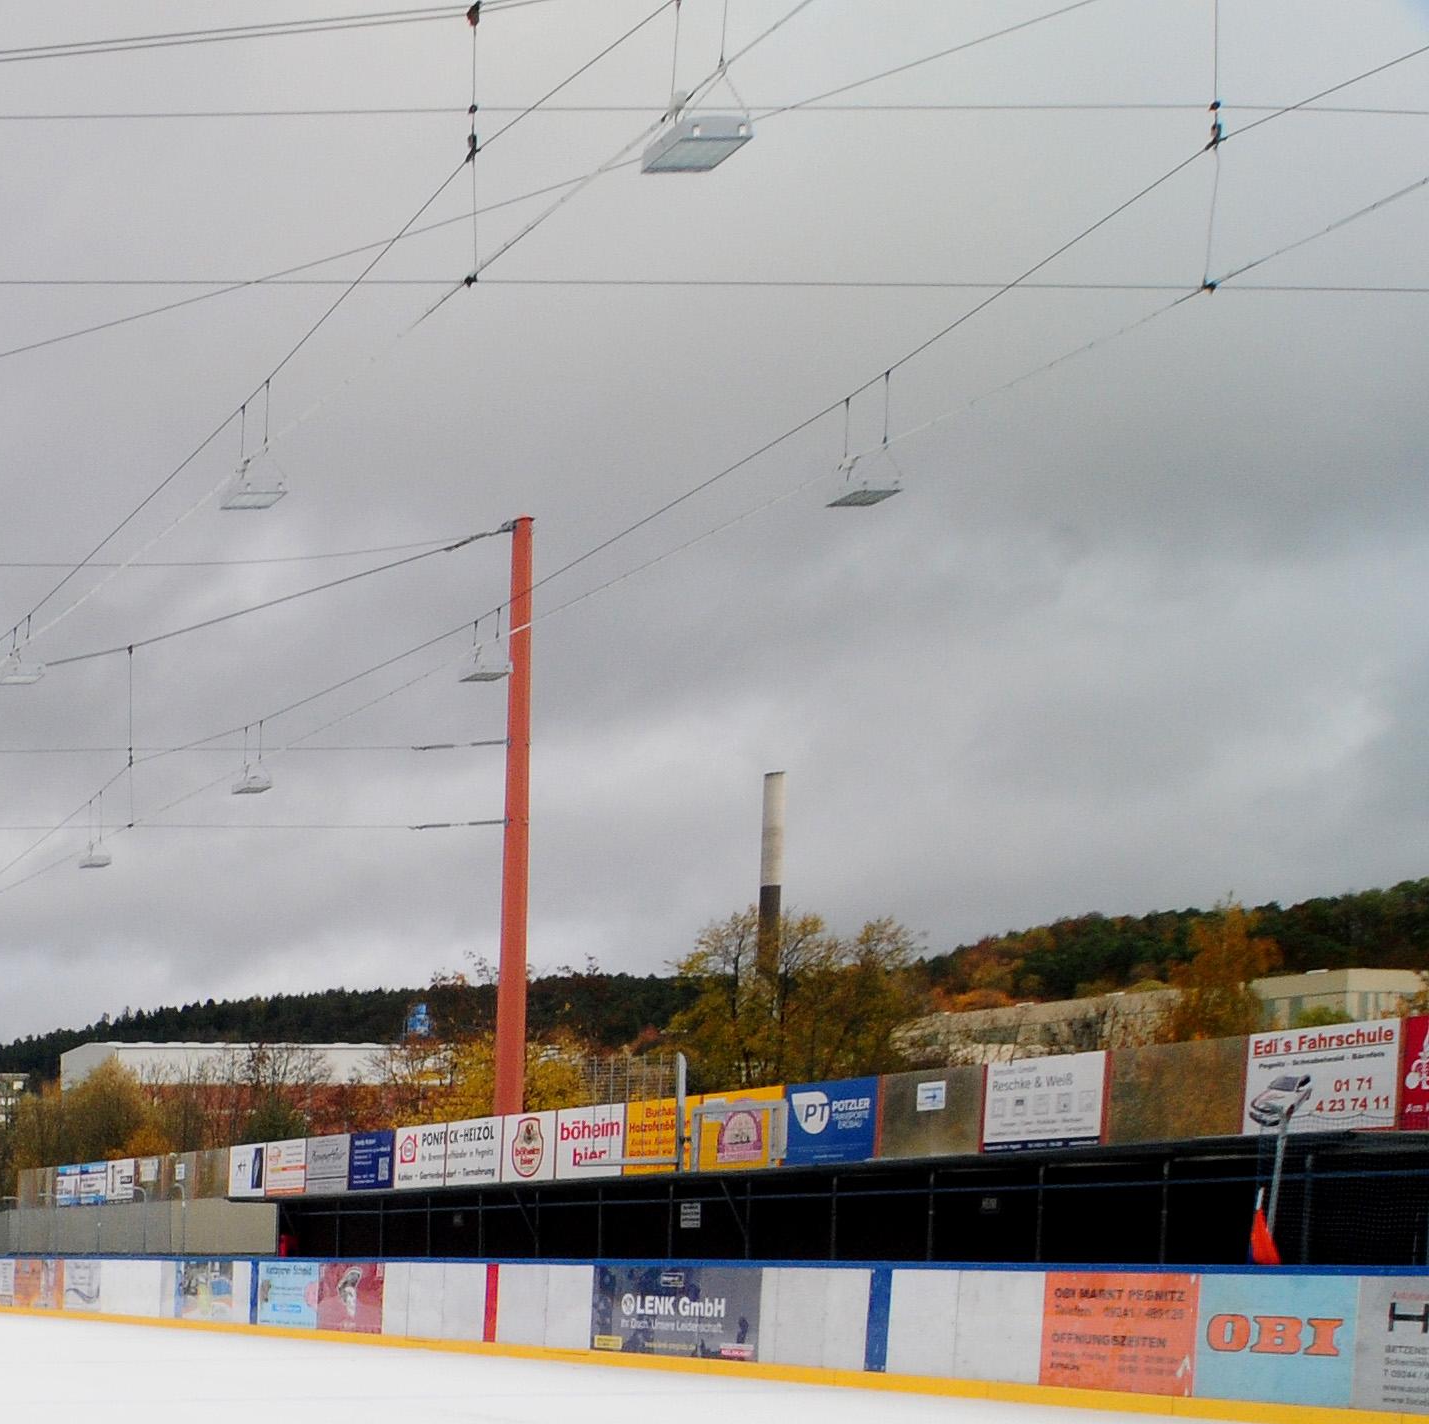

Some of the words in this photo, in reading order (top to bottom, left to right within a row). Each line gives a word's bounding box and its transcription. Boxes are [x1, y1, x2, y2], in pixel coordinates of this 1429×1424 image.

[1298, 1026, 1395, 1051] Fahrschule
[1034, 1076, 1043, 1088] &
[1333, 1079, 1350, 1093] 01
[1356, 1076, 1373, 1091] 71
[804, 1103, 830, 1123] PT
[1316, 1101, 1324, 1113] 4
[1328, 1099, 1346, 1113] 23
[1351, 1098, 1368, 1112] 74
[1373, 1095, 1390, 1110] 11
[560, 1118, 620, 1141] böheim
[1079, 1288, 1124, 1300] MARKT
[1128, 1289, 1187, 1302] PEGNITZ
[636, 1295, 676, 1316] LENK
[678, 1296, 726, 1318] GmbH
[1207, 1313, 1344, 1357] OBI
